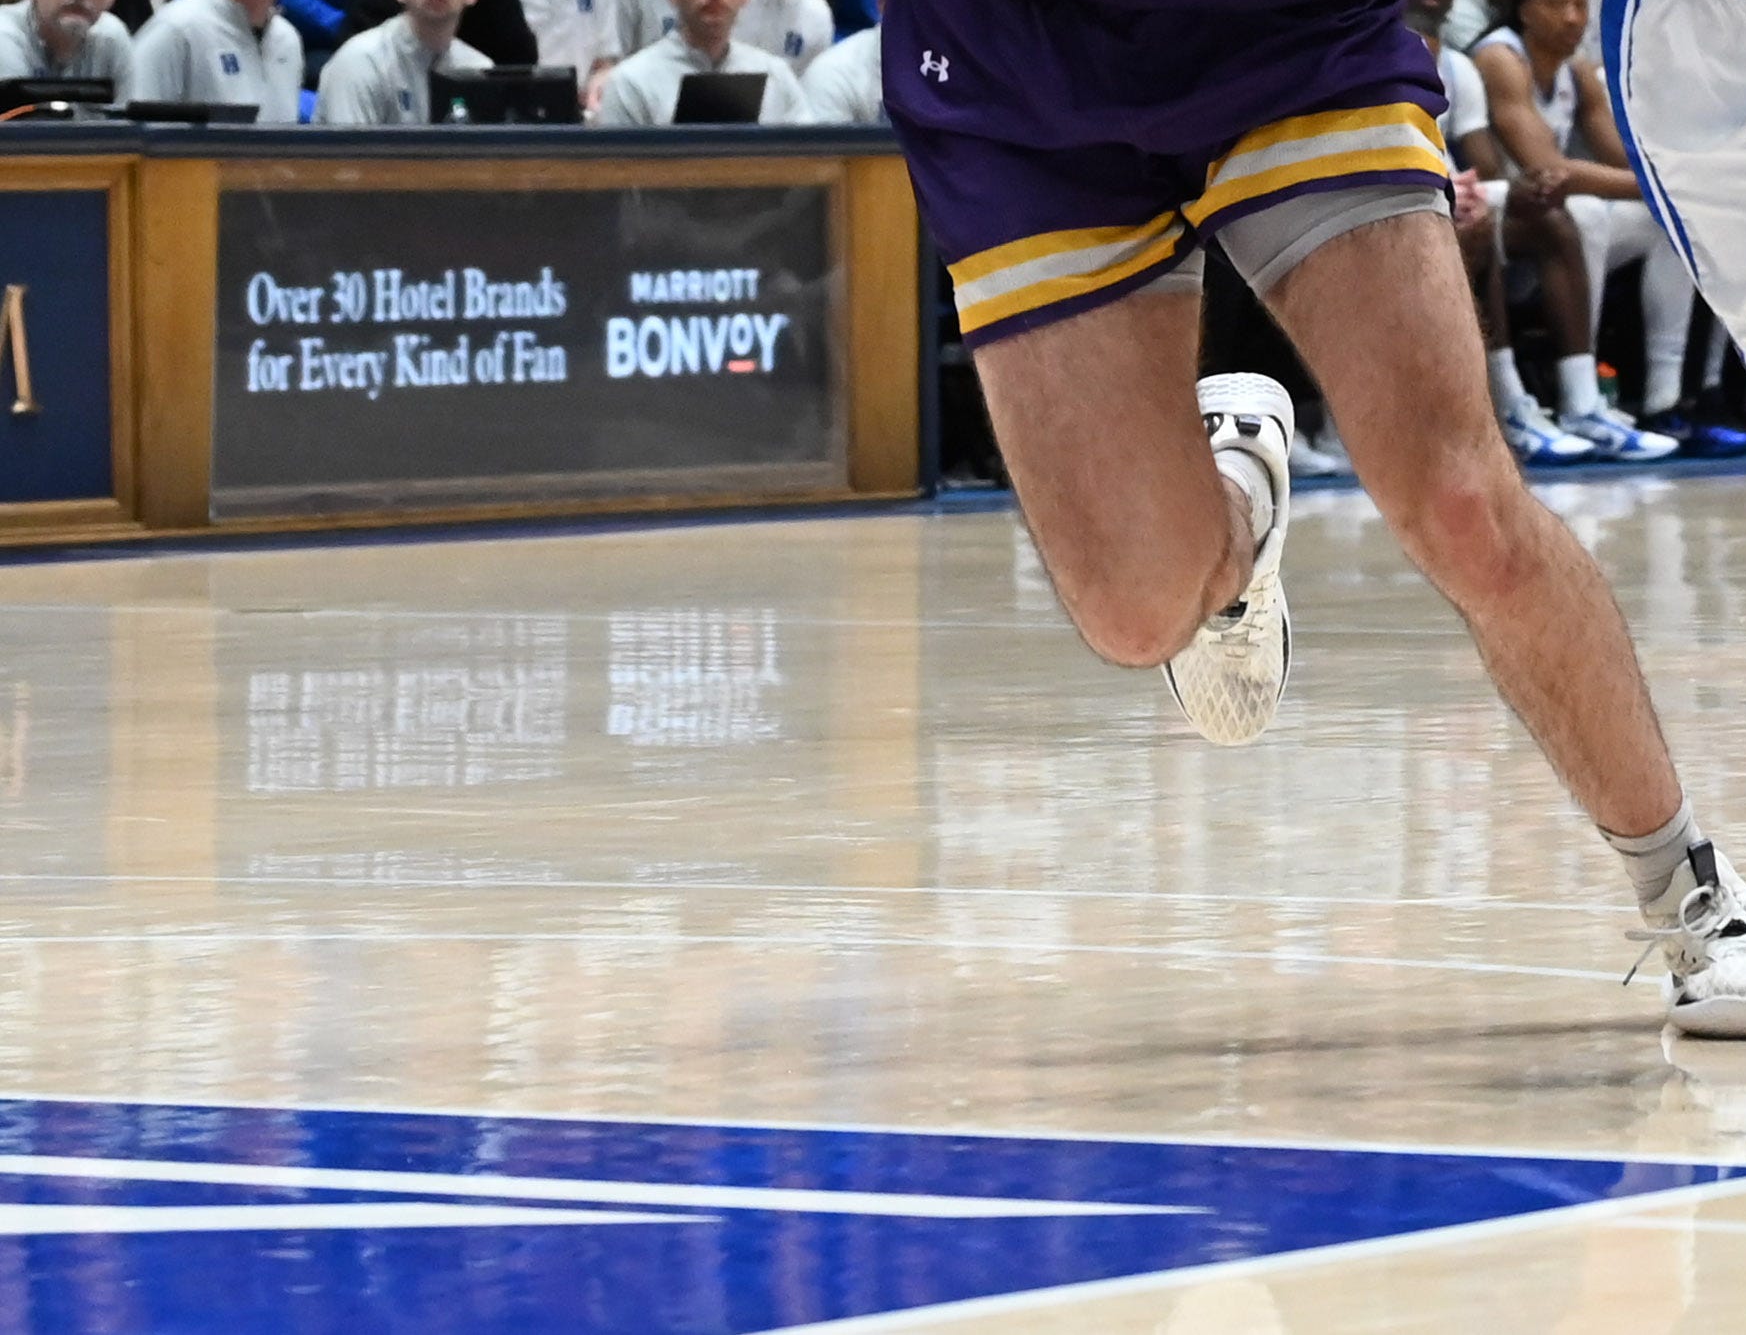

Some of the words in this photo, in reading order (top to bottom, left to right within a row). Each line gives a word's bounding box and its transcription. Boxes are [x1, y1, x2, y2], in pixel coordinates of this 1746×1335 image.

[246, 272, 323, 325] Over
[331, 271, 367, 323] 30
[372, 268, 456, 322] Hotel
[463, 268, 568, 319] Brands
[630, 269, 761, 304] MARRIOTT
[246, 339, 293, 393] for
[298, 337, 387, 401] Every
[393, 334, 470, 388] Kind
[475, 333, 508, 384] of
[512, 331, 568, 384] Fan
[606, 313, 784, 379] BONVOY
